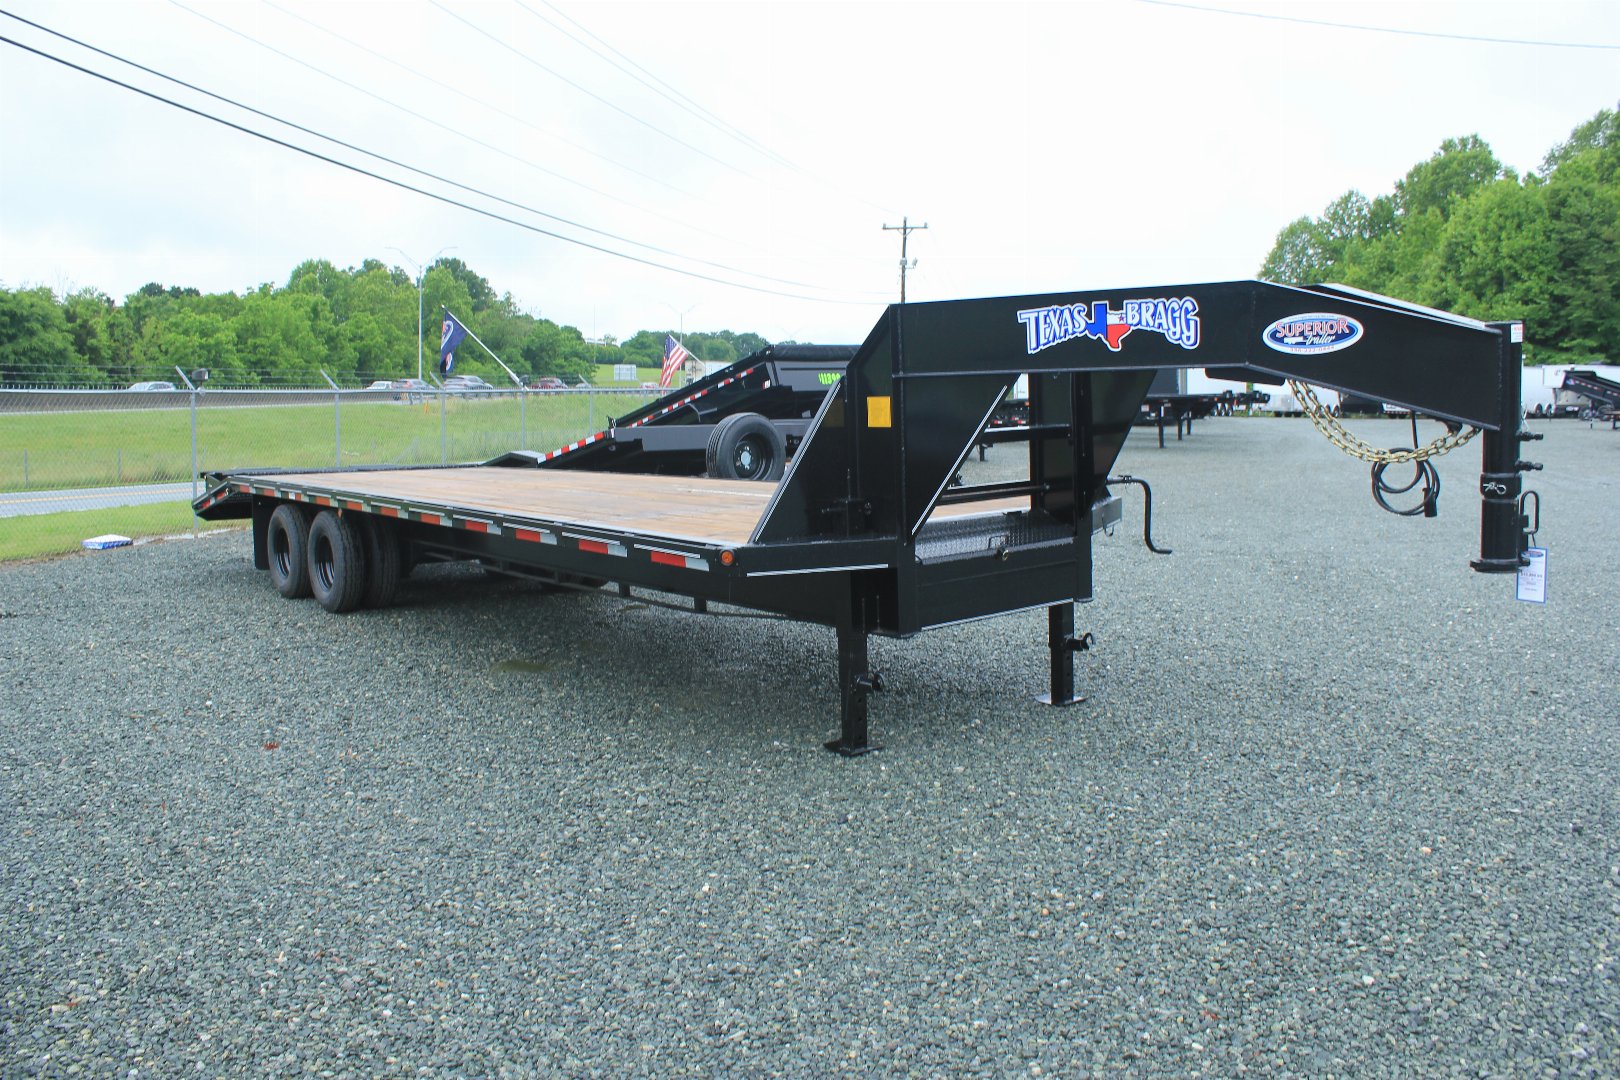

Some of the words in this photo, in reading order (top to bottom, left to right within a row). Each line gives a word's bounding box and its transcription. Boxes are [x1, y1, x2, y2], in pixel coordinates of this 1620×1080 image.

[1017, 303, 1087, 354] TEXAS
[1124, 297, 1200, 349] BRAGG
[1275, 318, 1350, 338] SUPERIOR
